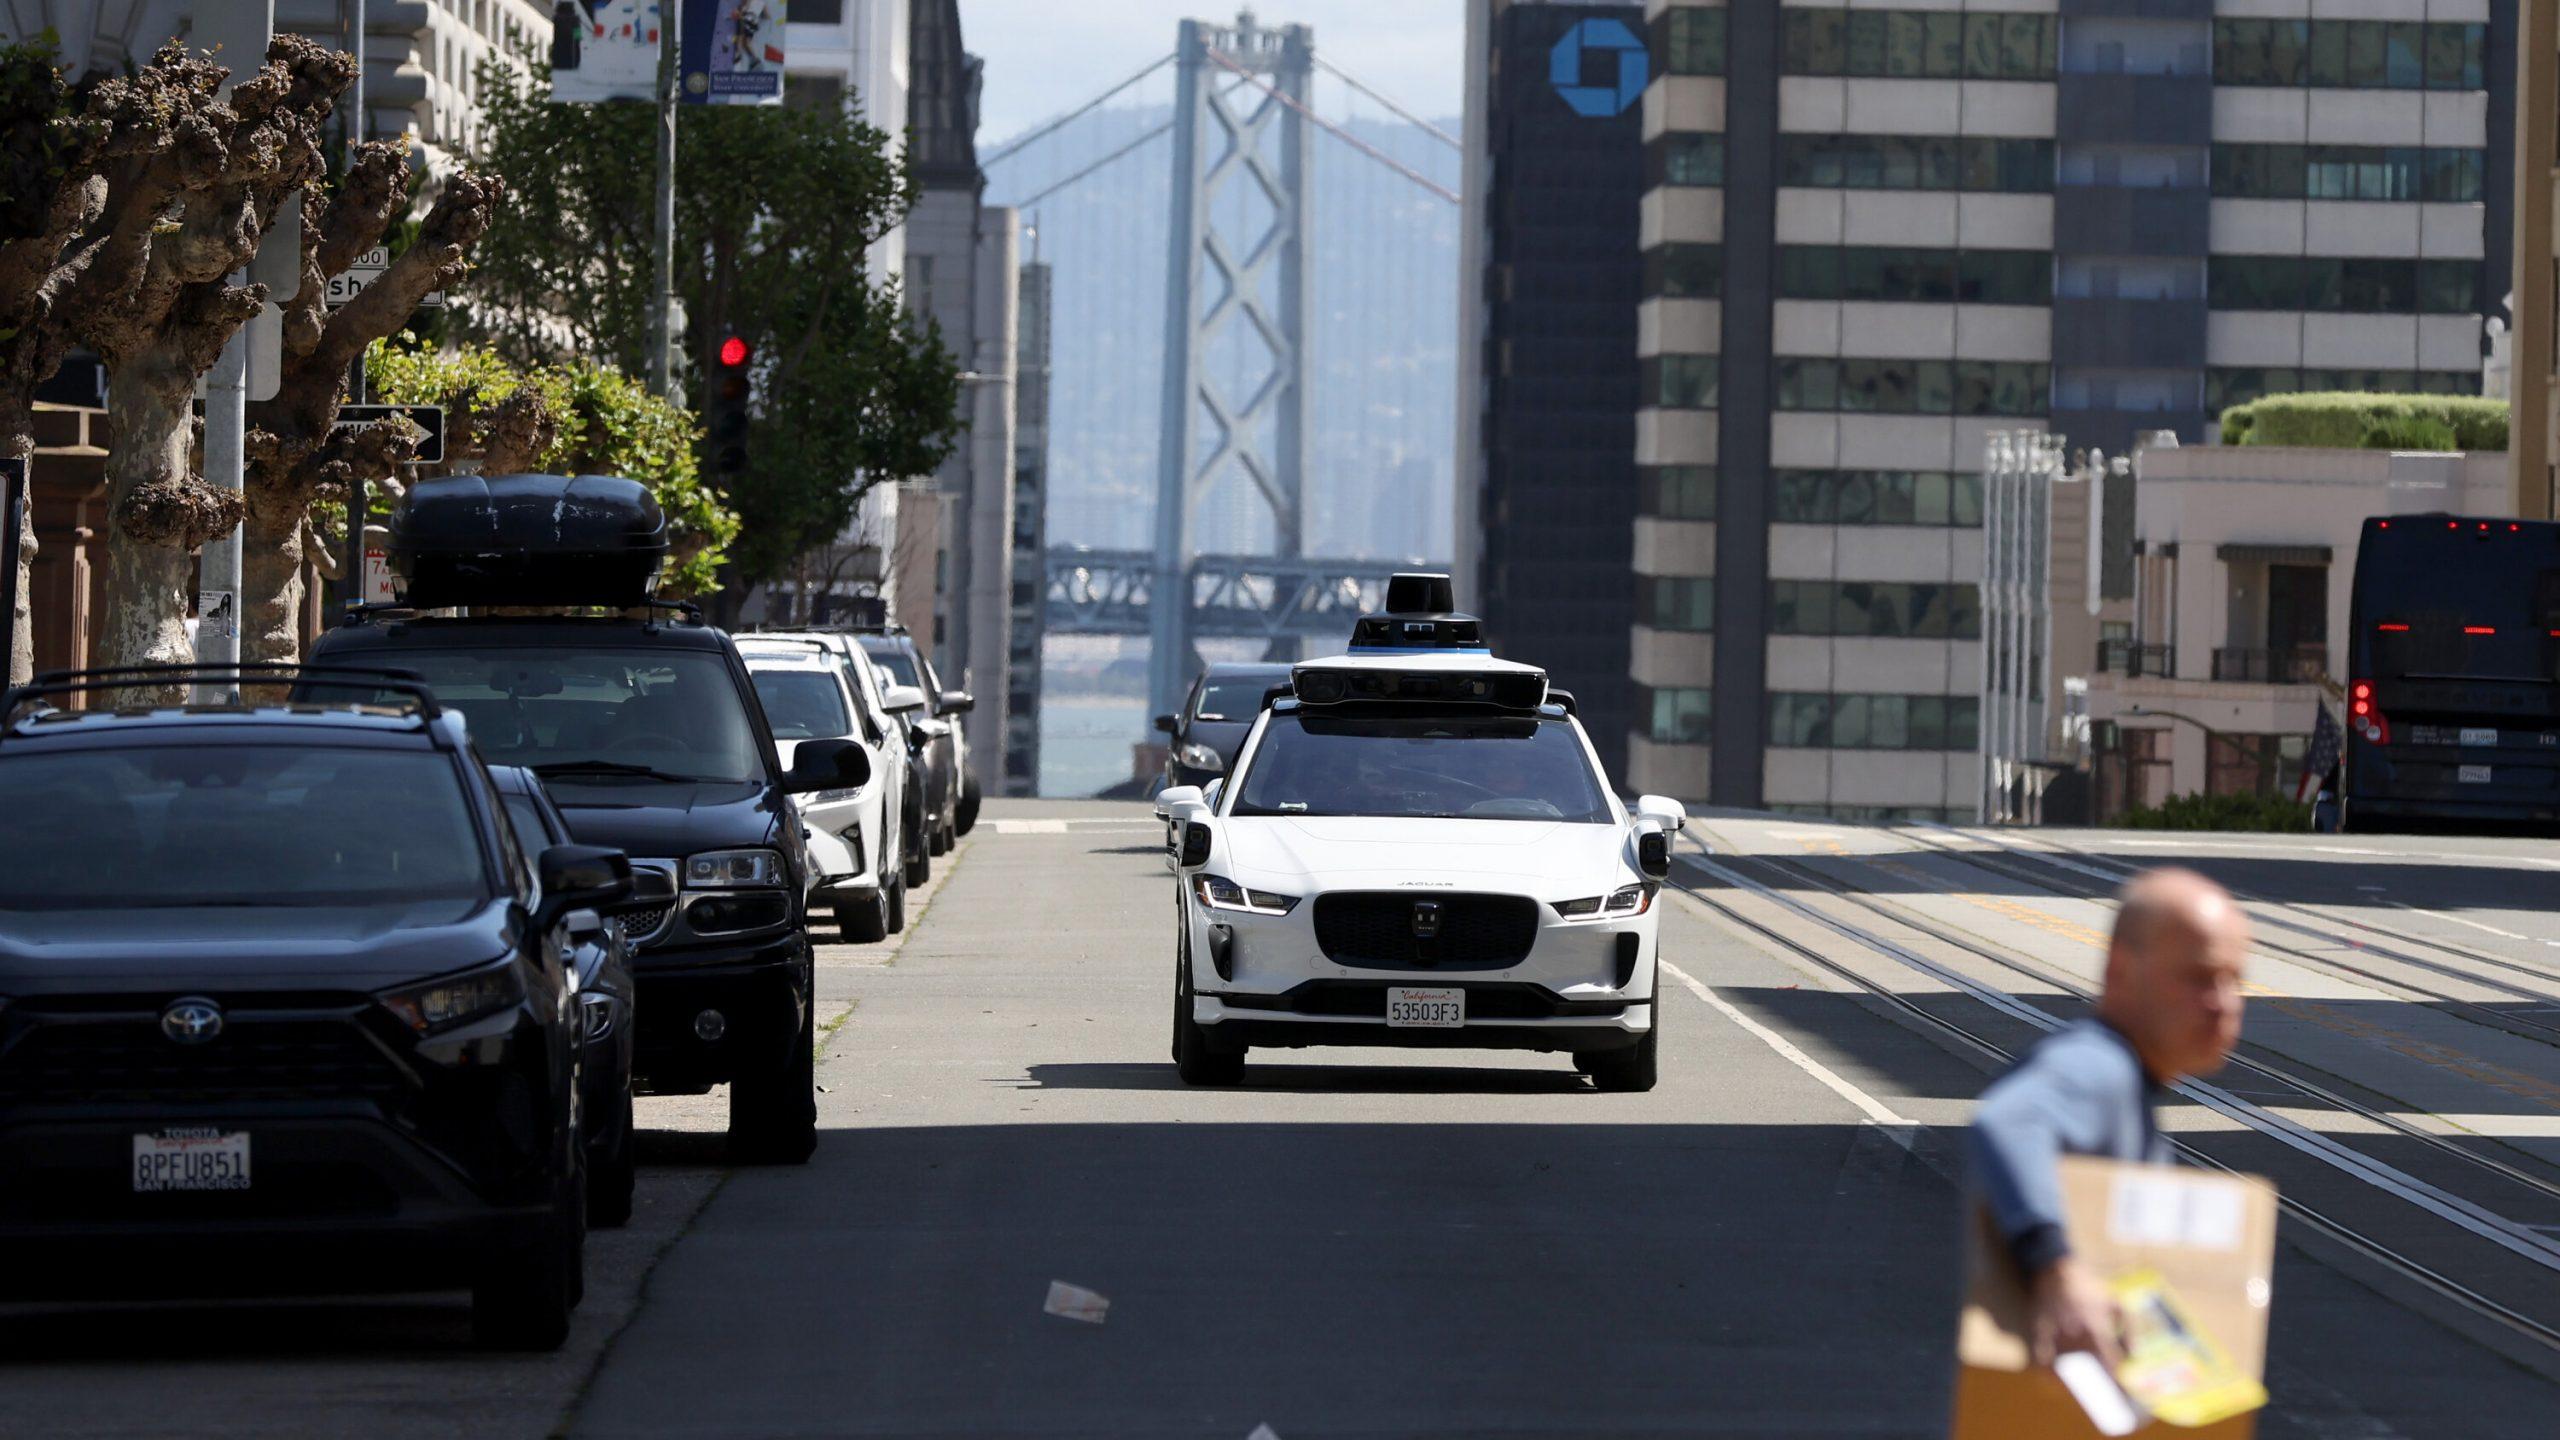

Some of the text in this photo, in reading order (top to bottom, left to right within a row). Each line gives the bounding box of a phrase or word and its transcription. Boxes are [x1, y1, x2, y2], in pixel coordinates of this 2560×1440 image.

[330, 276, 367, 296] sh
[1403, 990, 1449, 1003] California
[1392, 1002, 1459, 1021] 53503F3
[163, 1127, 220, 1138] TOYOTA
[138, 1152, 243, 1180] 8PFU851
[133, 1178, 252, 1192] SAN FRANCISCO
